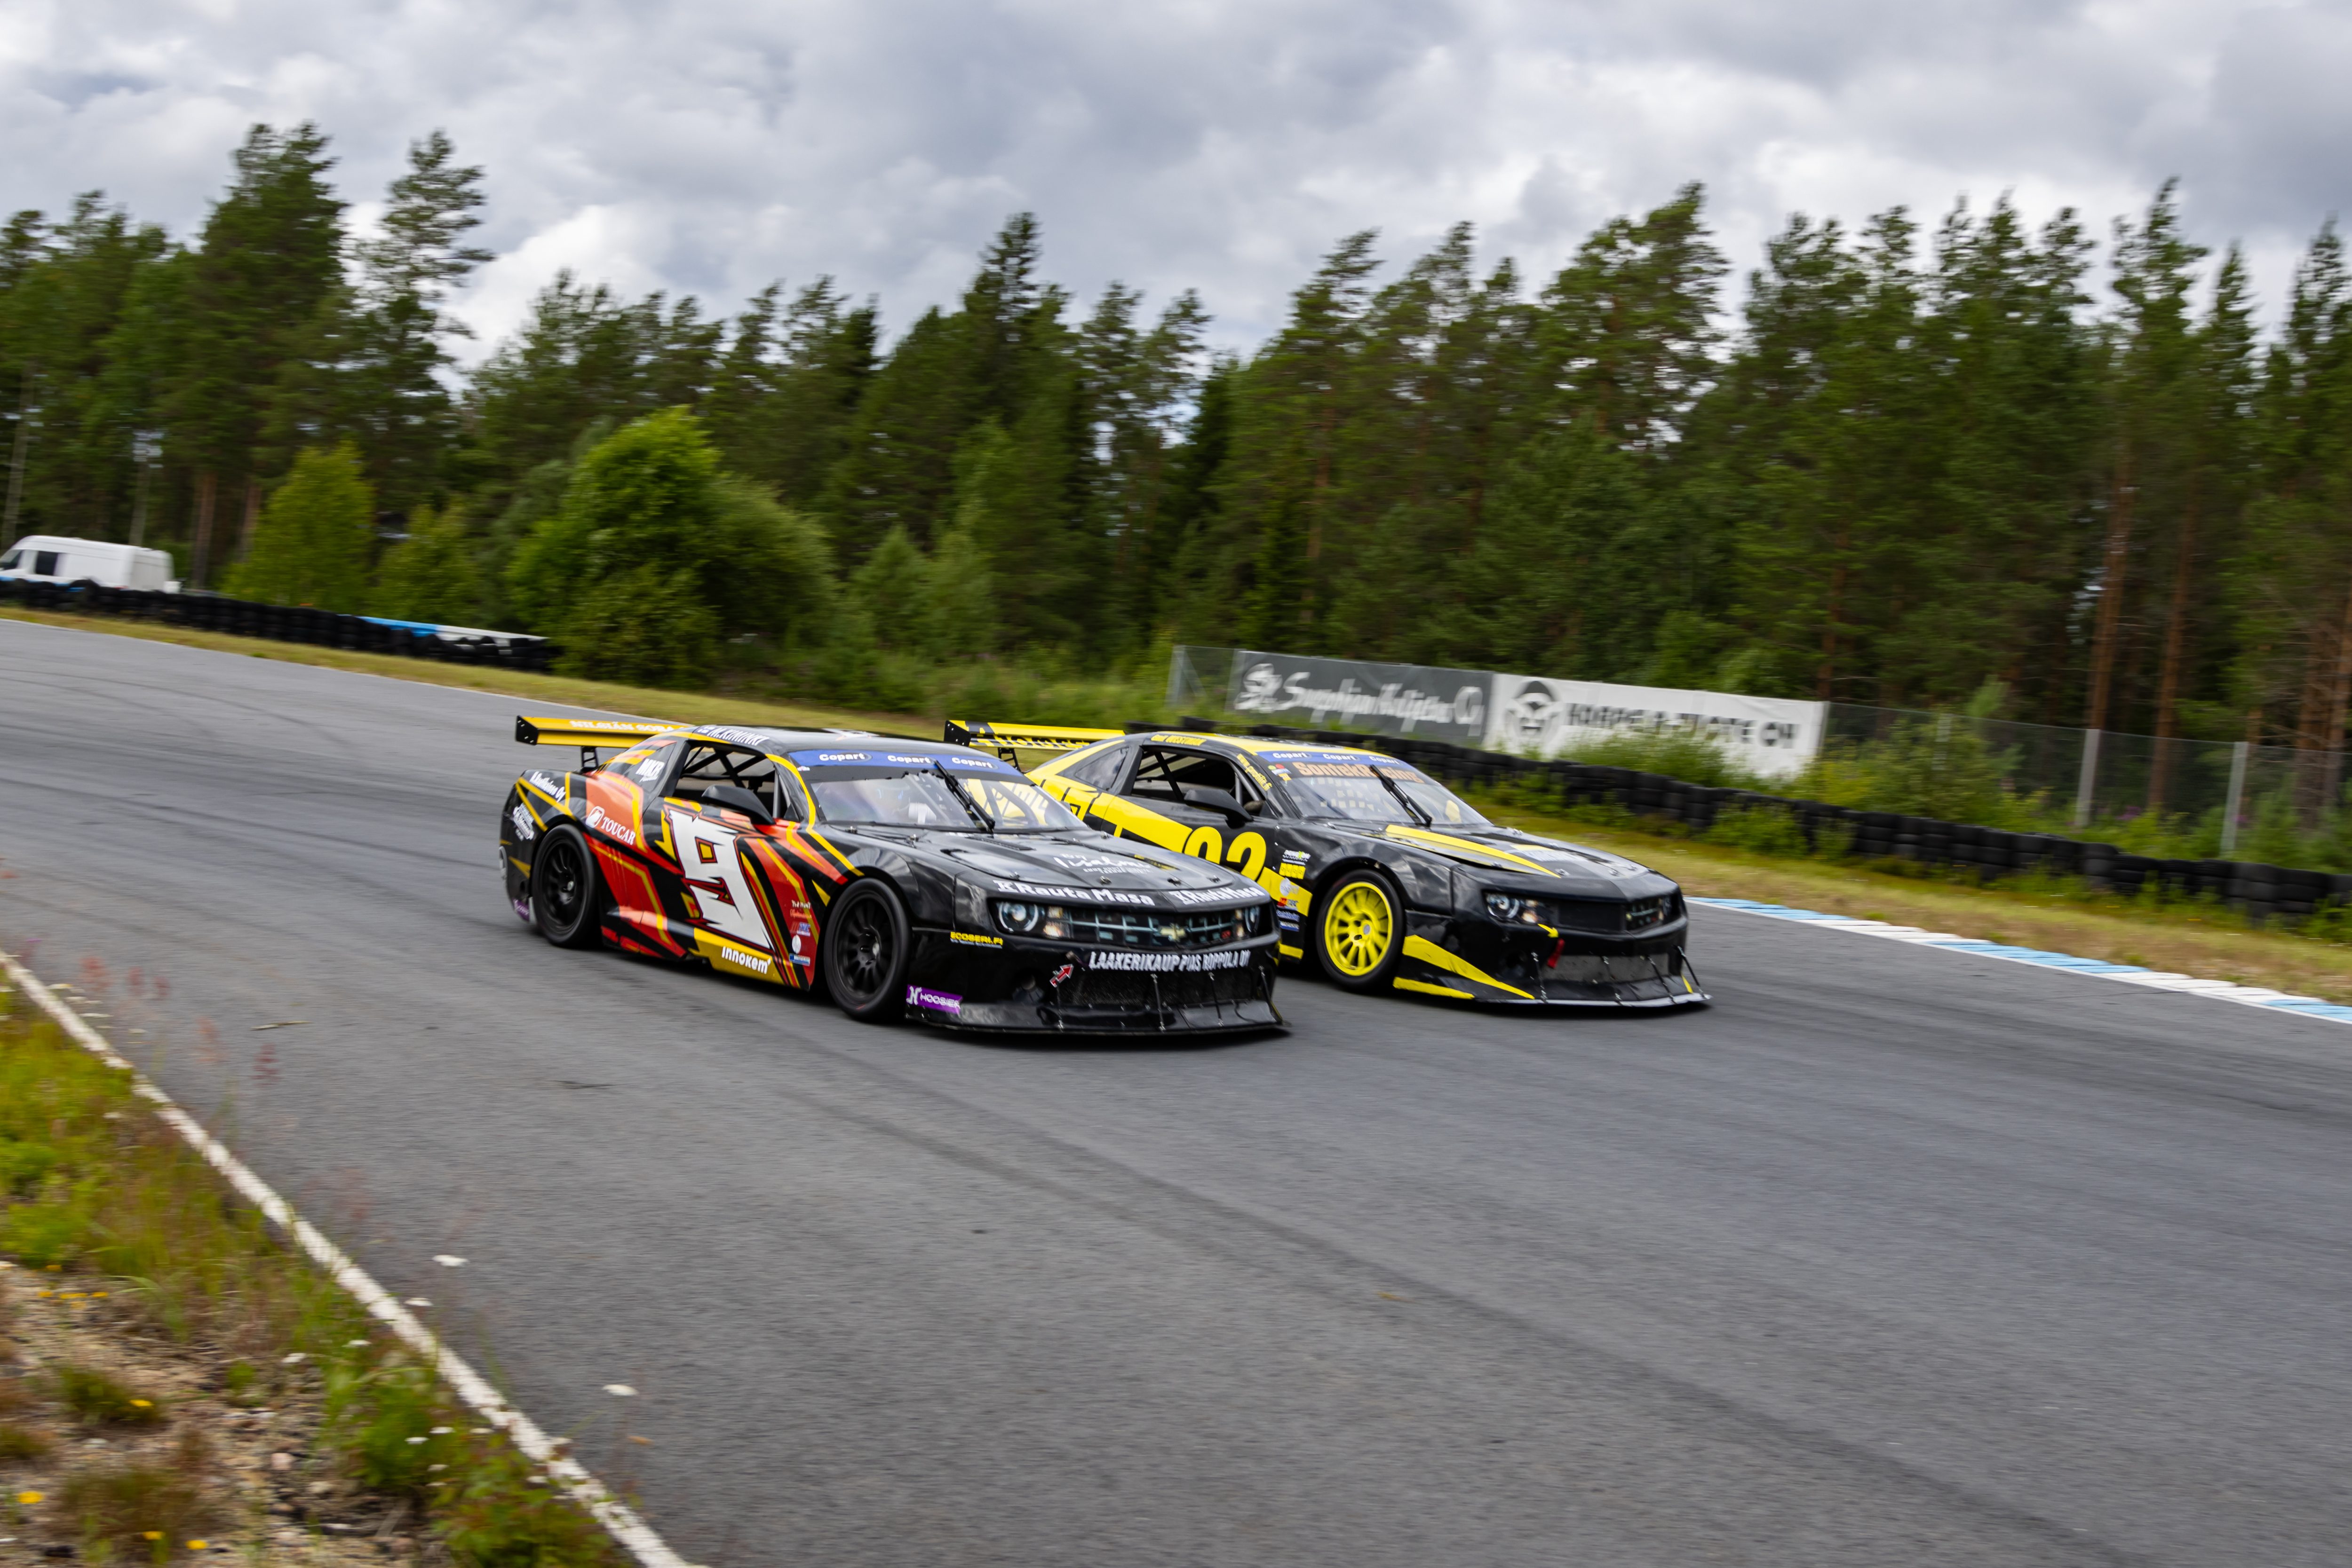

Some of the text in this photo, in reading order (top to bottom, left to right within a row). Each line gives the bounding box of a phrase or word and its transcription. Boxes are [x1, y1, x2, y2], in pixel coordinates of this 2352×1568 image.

[819, 753, 865, 761] Copart
[887, 755, 931, 764] Copart
[952, 757, 993, 768] Copart
[1369, 756, 1401, 765] Copart
[1293, 761, 1425, 784] SontekRcing
[601, 816, 636, 845] TOUCAR
[668, 809, 772, 949] 9
[1090, 889, 1155, 906] Masa
